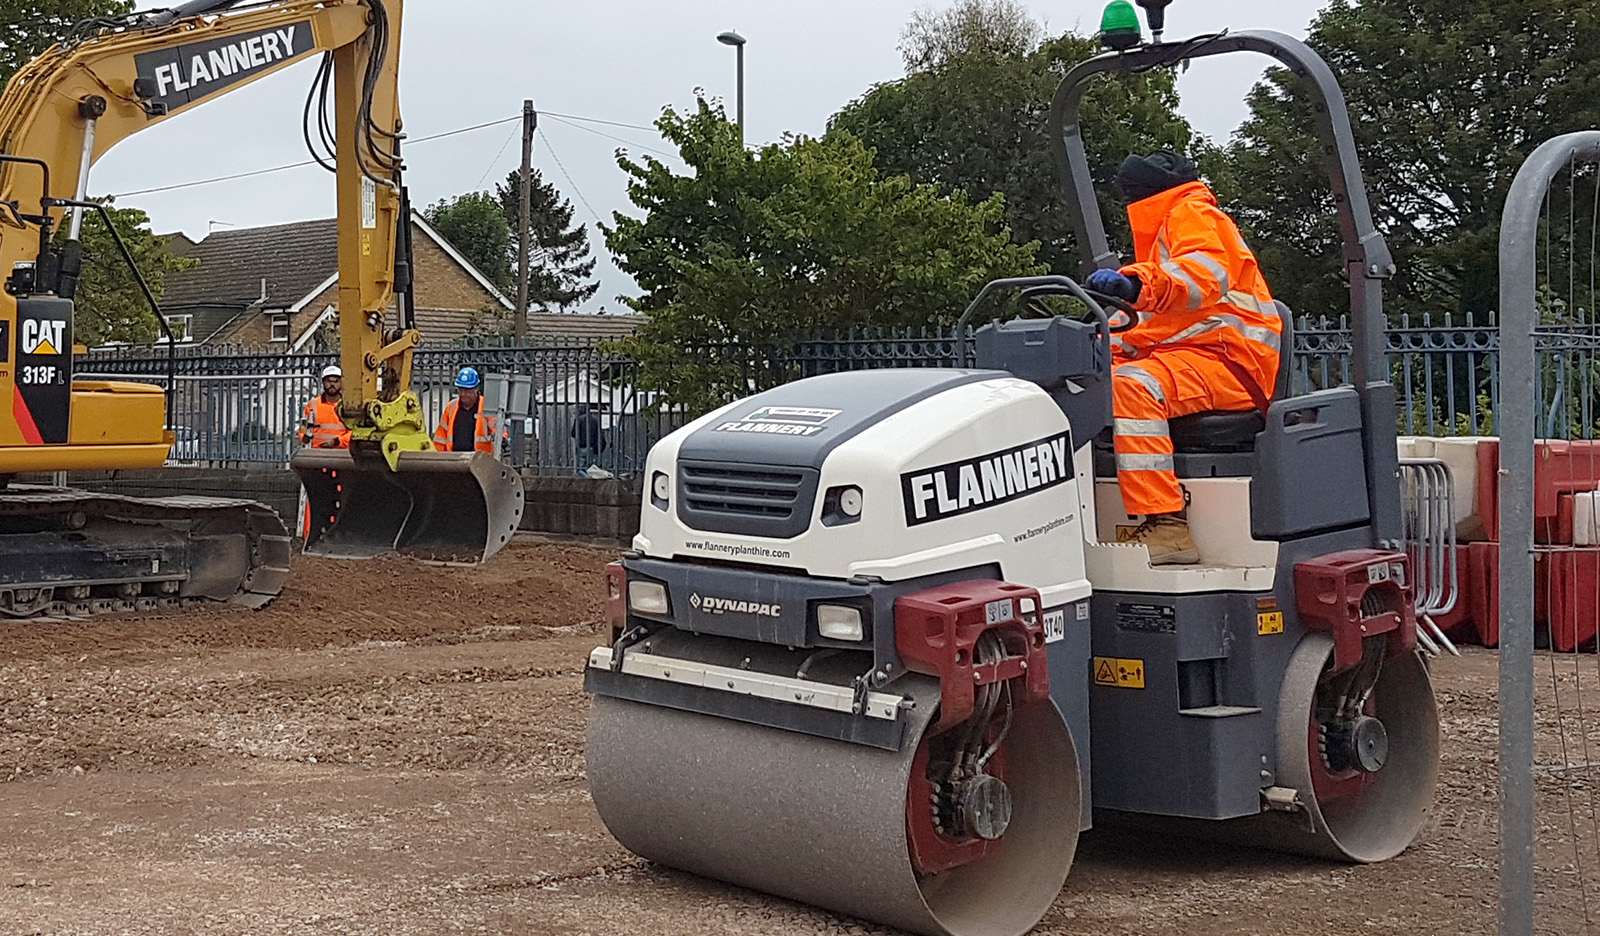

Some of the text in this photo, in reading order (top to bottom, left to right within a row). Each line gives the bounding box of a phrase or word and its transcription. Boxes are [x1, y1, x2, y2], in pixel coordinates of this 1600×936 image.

[154, 25, 296, 97] FLANNERY
[22, 318, 66, 355] CAT
[23, 365, 65, 385] 313F L
[715, 421, 823, 437] FLANNERY
[910, 436, 1066, 519] FLANNERY
[685, 541, 791, 559] www.flanneryplanthire.com
[702, 596, 782, 617] DYNAPAC
